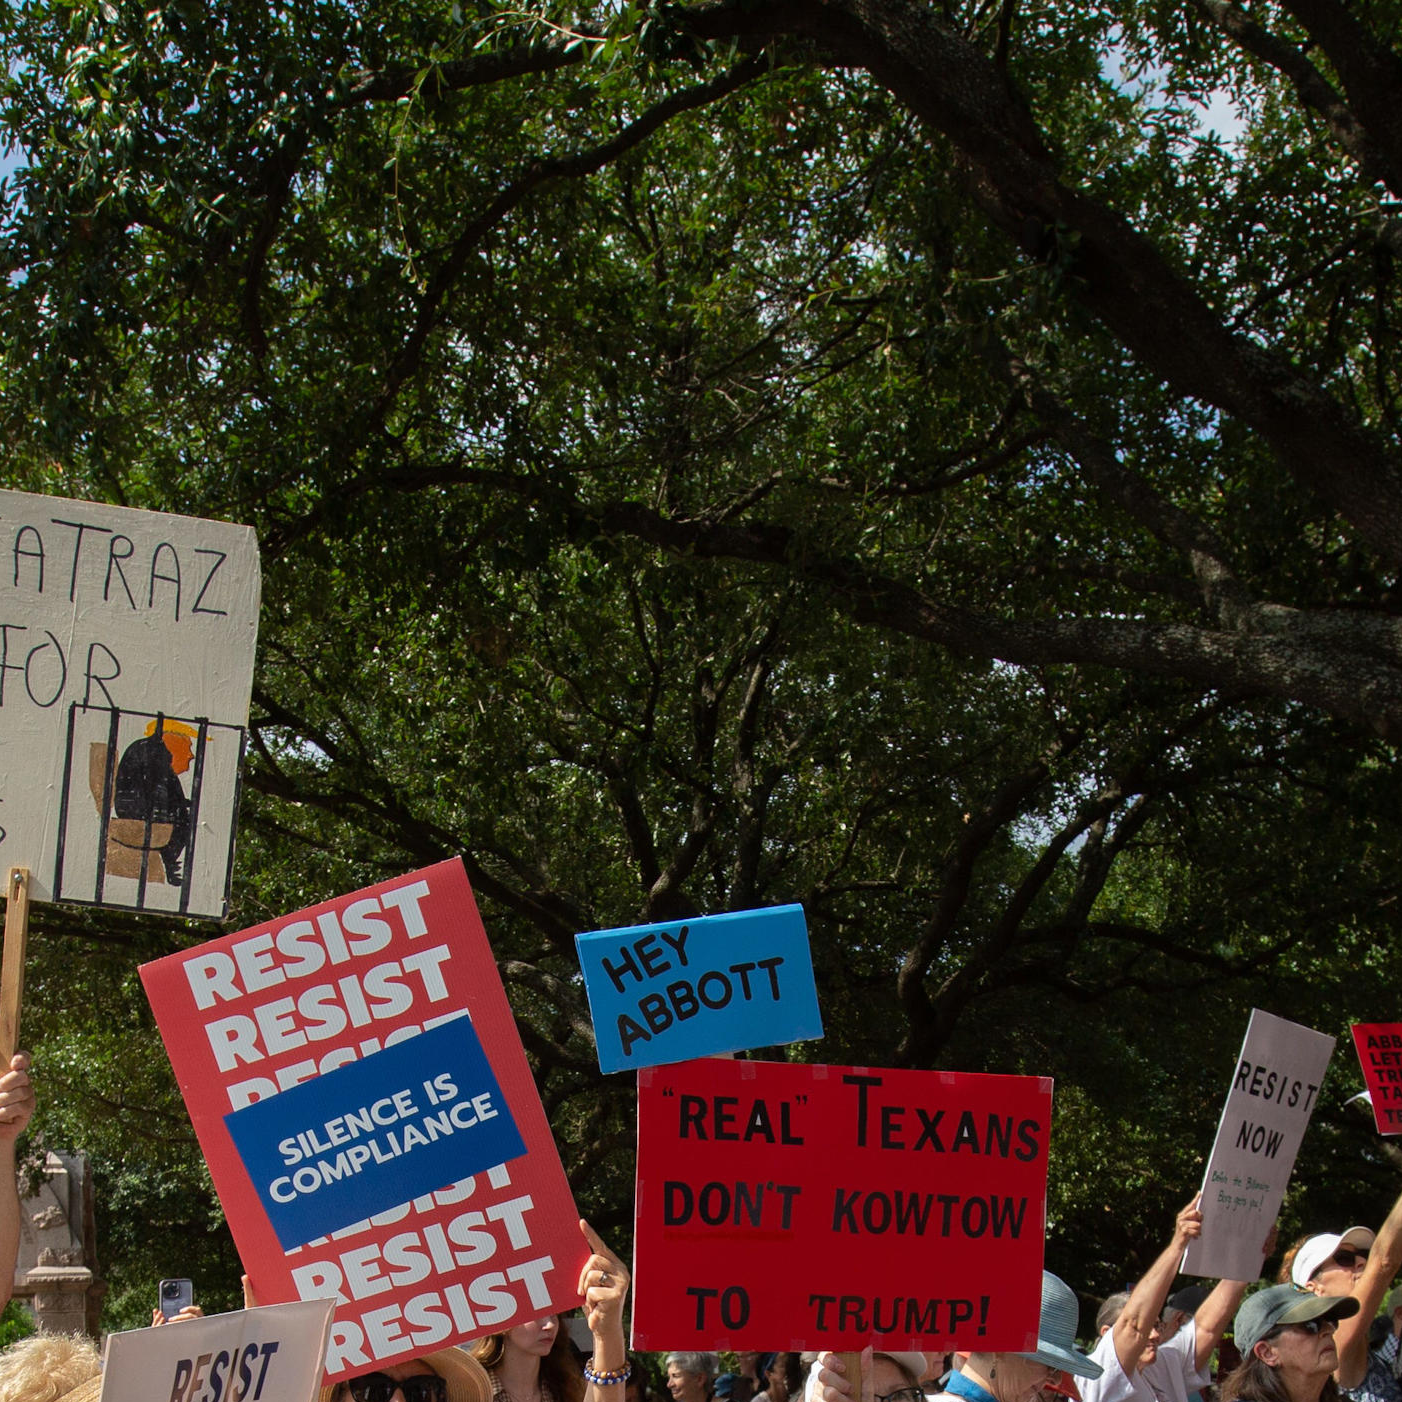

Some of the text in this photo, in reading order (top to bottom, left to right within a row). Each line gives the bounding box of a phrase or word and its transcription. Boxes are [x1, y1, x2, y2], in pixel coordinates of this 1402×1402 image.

[182, 880, 430, 1011] RESIST
[601, 926, 690, 994] HEY
[204, 945, 451, 1074] RESIST
[616, 957, 784, 1056] ABBOTT
[278, 1072, 458, 1166] SILENCE IS
[1234, 1060, 1318, 1114] RESIST
[269, 1092, 498, 1204] COMPLIANCE
[1235, 1120, 1285, 1160] NOW
[291, 1195, 534, 1305] RESIST
[663, 1181, 1028, 1240] DON'T KOWTOW
[325, 1256, 554, 1376] RESIST
[686, 1285, 991, 1337] TO TRUMP!
